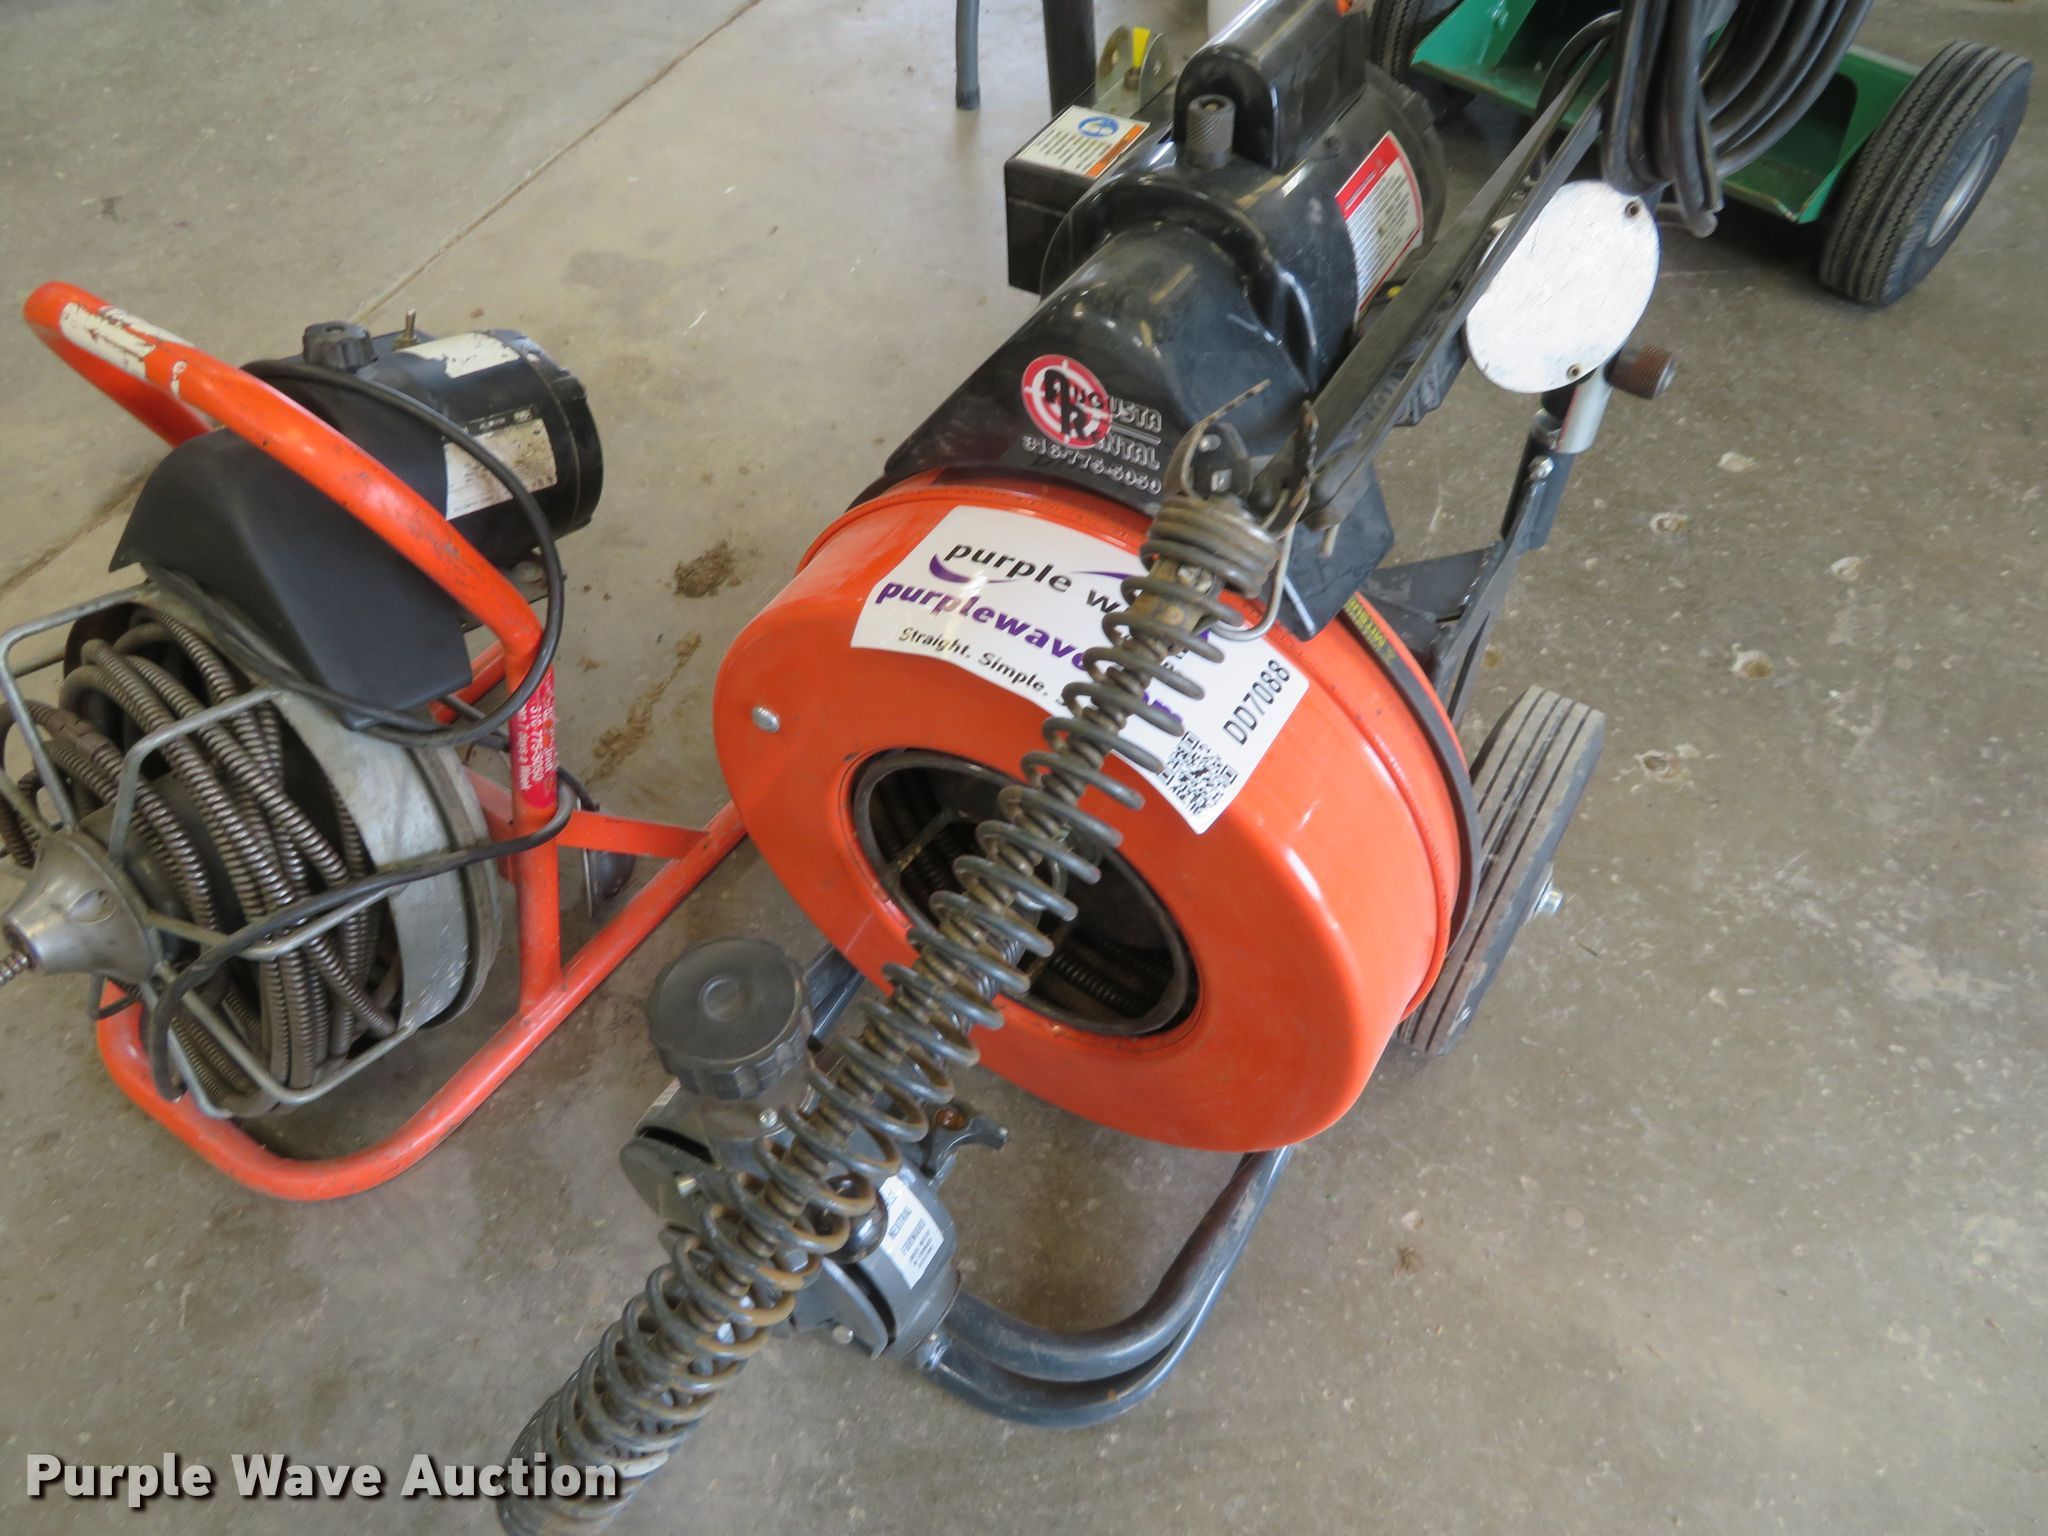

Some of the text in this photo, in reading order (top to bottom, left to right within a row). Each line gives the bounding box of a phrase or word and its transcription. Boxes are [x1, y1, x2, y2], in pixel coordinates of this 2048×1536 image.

[944, 543, 1072, 592] purple
[897, 627, 1049, 697] Straight. Simple.
[1222, 658, 1292, 746] DD7088
